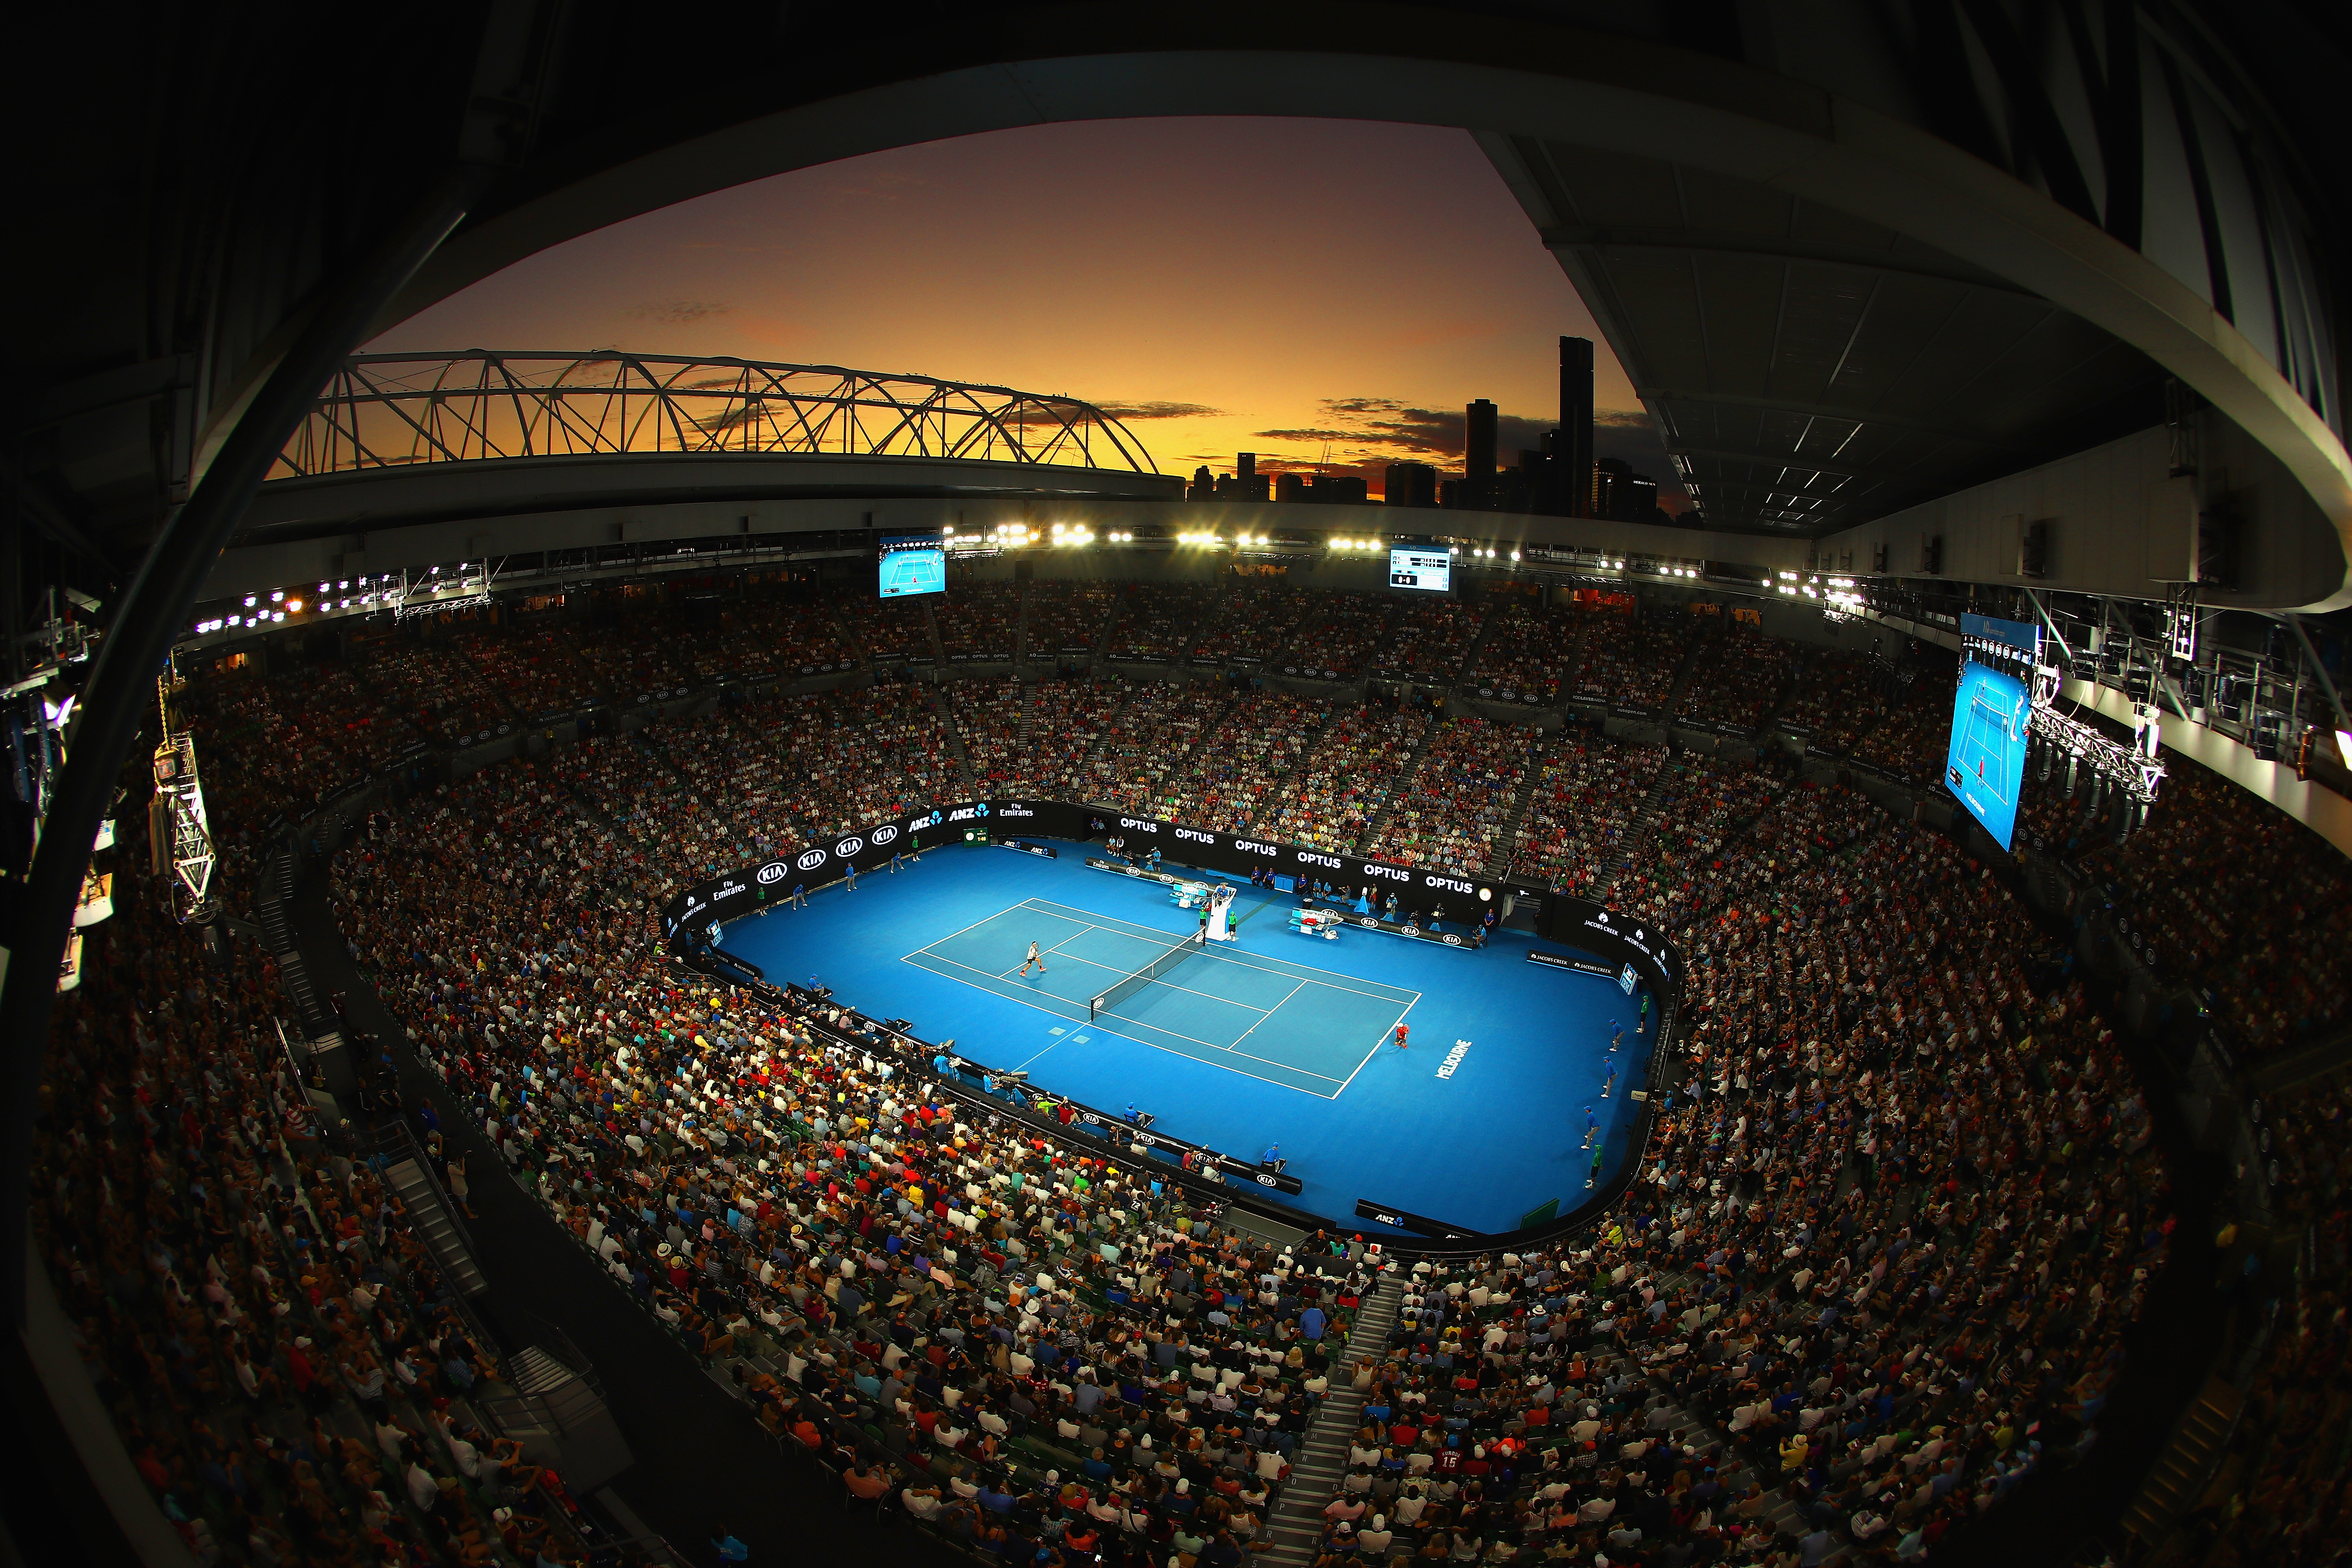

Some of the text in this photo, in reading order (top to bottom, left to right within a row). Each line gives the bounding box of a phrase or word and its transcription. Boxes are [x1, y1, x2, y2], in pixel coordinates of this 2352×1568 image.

[1617, 708, 1647, 716] ausopen.com
[949, 808, 974, 821] ANZ
[908, 817, 929, 832] ANZ
[1121, 818, 1158, 833] OPTUS
[876, 829, 894, 842] KIA
[1176, 829, 1214, 844] OPTUS
[840, 841, 859, 854] KIA
[1235, 840, 1277, 857] OPTUS
[802, 853, 822, 867] KIA
[1093, 861, 1109, 870] Emirates
[1298, 852, 1341, 869] OPTUS
[762, 867, 782, 881] KIA
[1364, 864, 1410, 882] OPTUS
[1426, 876, 1473, 894] OPTUS
[713, 883, 746, 901] Emirates
[693, 902, 706, 914] CREEK
[1603, 926, 1619, 936] CREEK
[1638, 943, 1650, 955] CREEK
[1434, 1039, 1472, 1079] MELBOURNE
[1140, 1135, 1152, 1143] KIA
[1375, 1214, 1394, 1224] ANZ
[1442, 1456, 1457, 1468] 15
[1266, 1530, 1272, 1538] R
[1311, 1536, 1317, 1545] R
